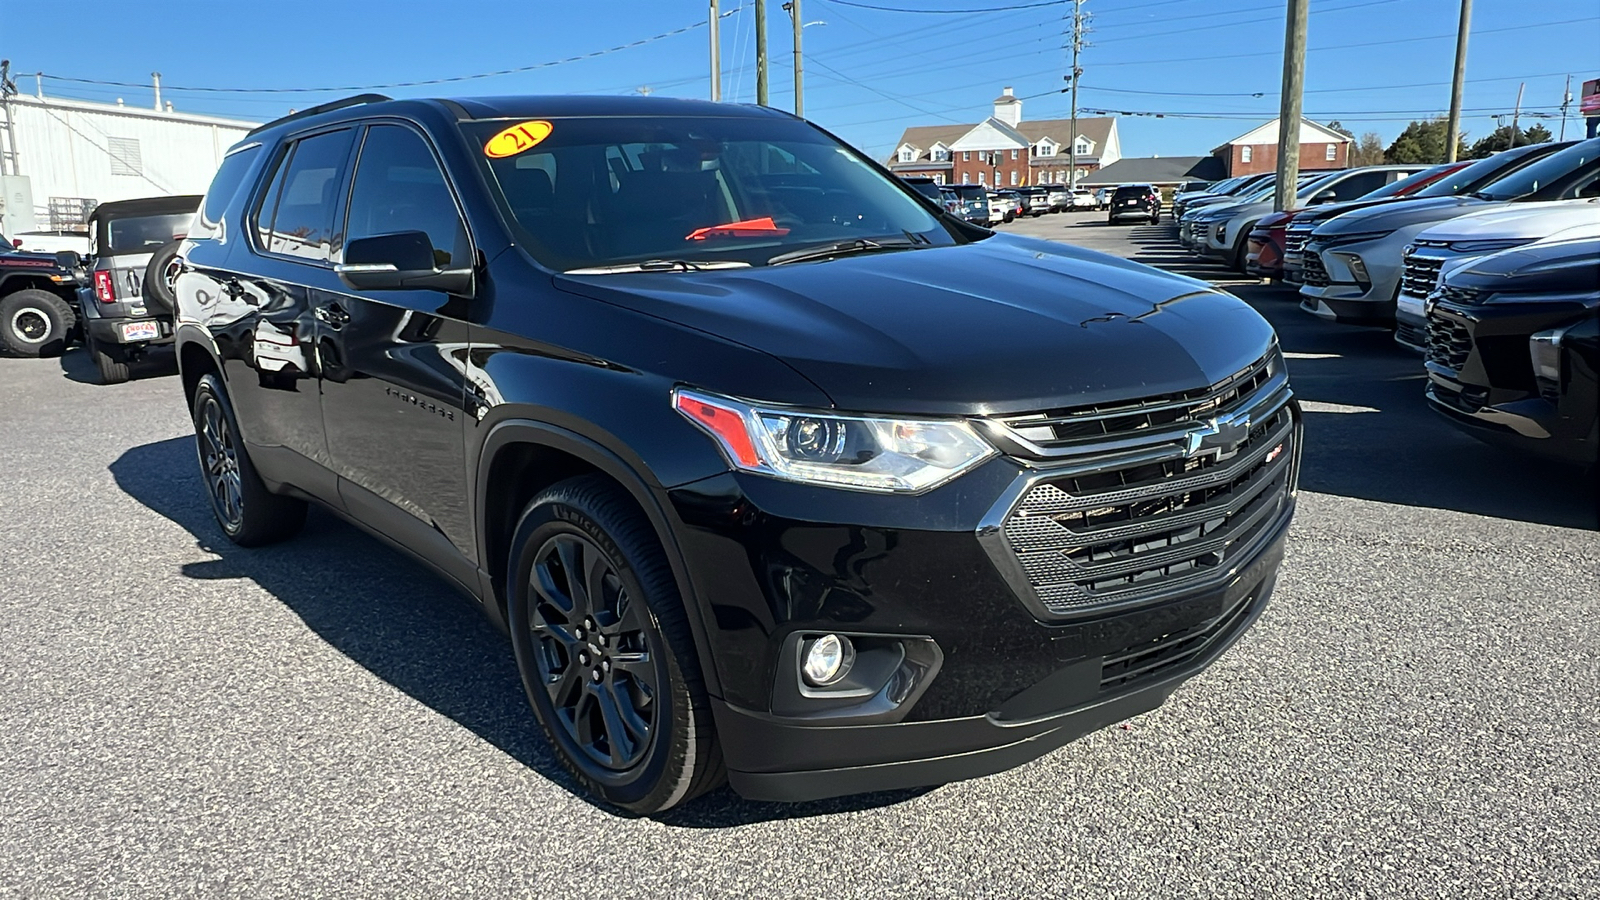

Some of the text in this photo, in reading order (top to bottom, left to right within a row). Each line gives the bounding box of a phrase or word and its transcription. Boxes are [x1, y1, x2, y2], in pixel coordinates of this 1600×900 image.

[503, 126, 538, 150] 21
[385, 386, 455, 422] TRAVERSE
[570, 511, 624, 567] MICHELIN
